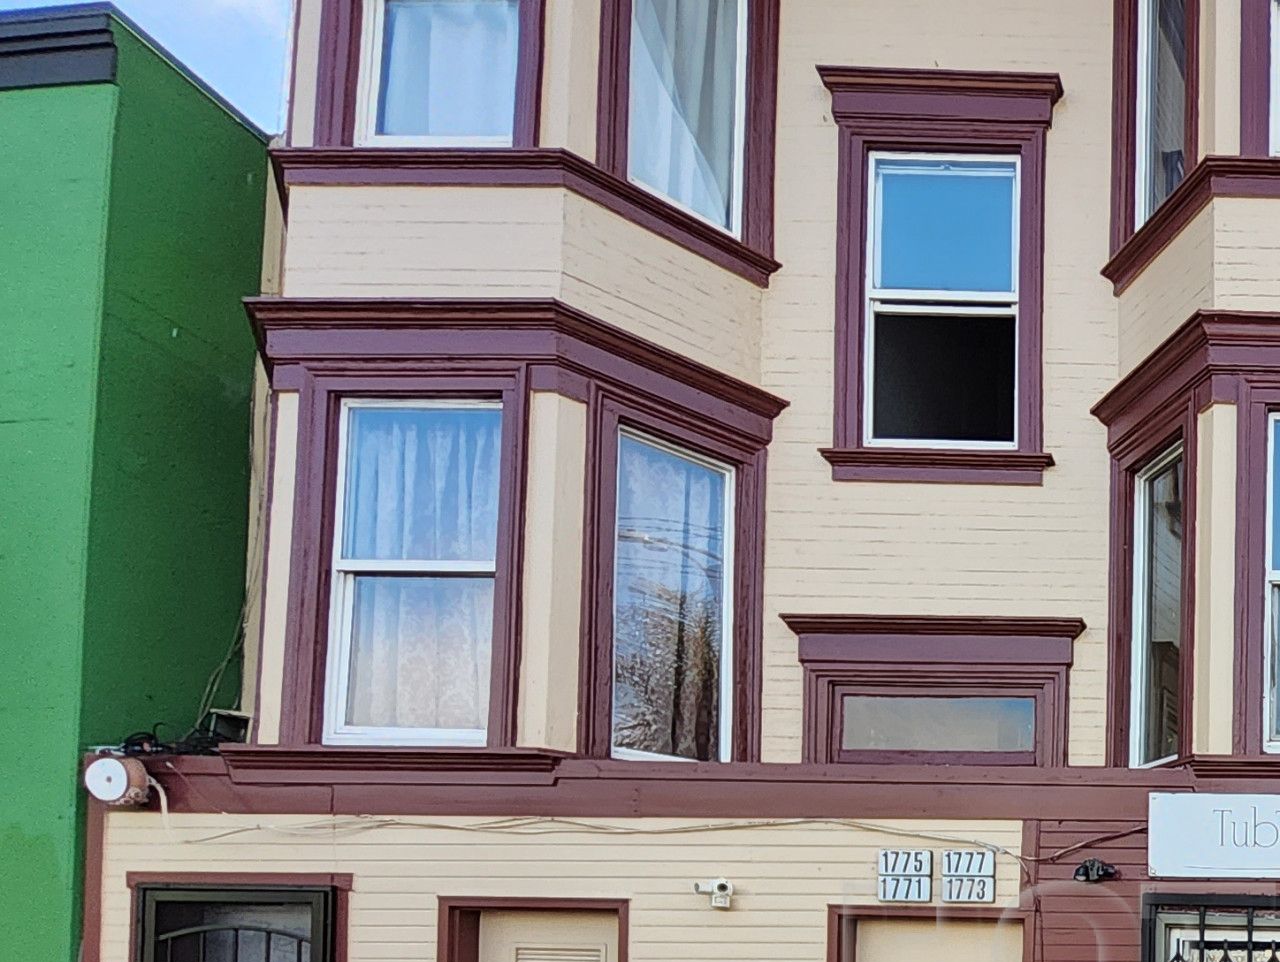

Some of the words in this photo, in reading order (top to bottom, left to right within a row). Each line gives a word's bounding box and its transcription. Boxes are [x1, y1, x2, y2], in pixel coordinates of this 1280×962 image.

[882, 851, 923, 873] 1775
[945, 851, 985, 873] 1777
[881, 878, 922, 900] 1771
[946, 878, 986, 900] 1773
